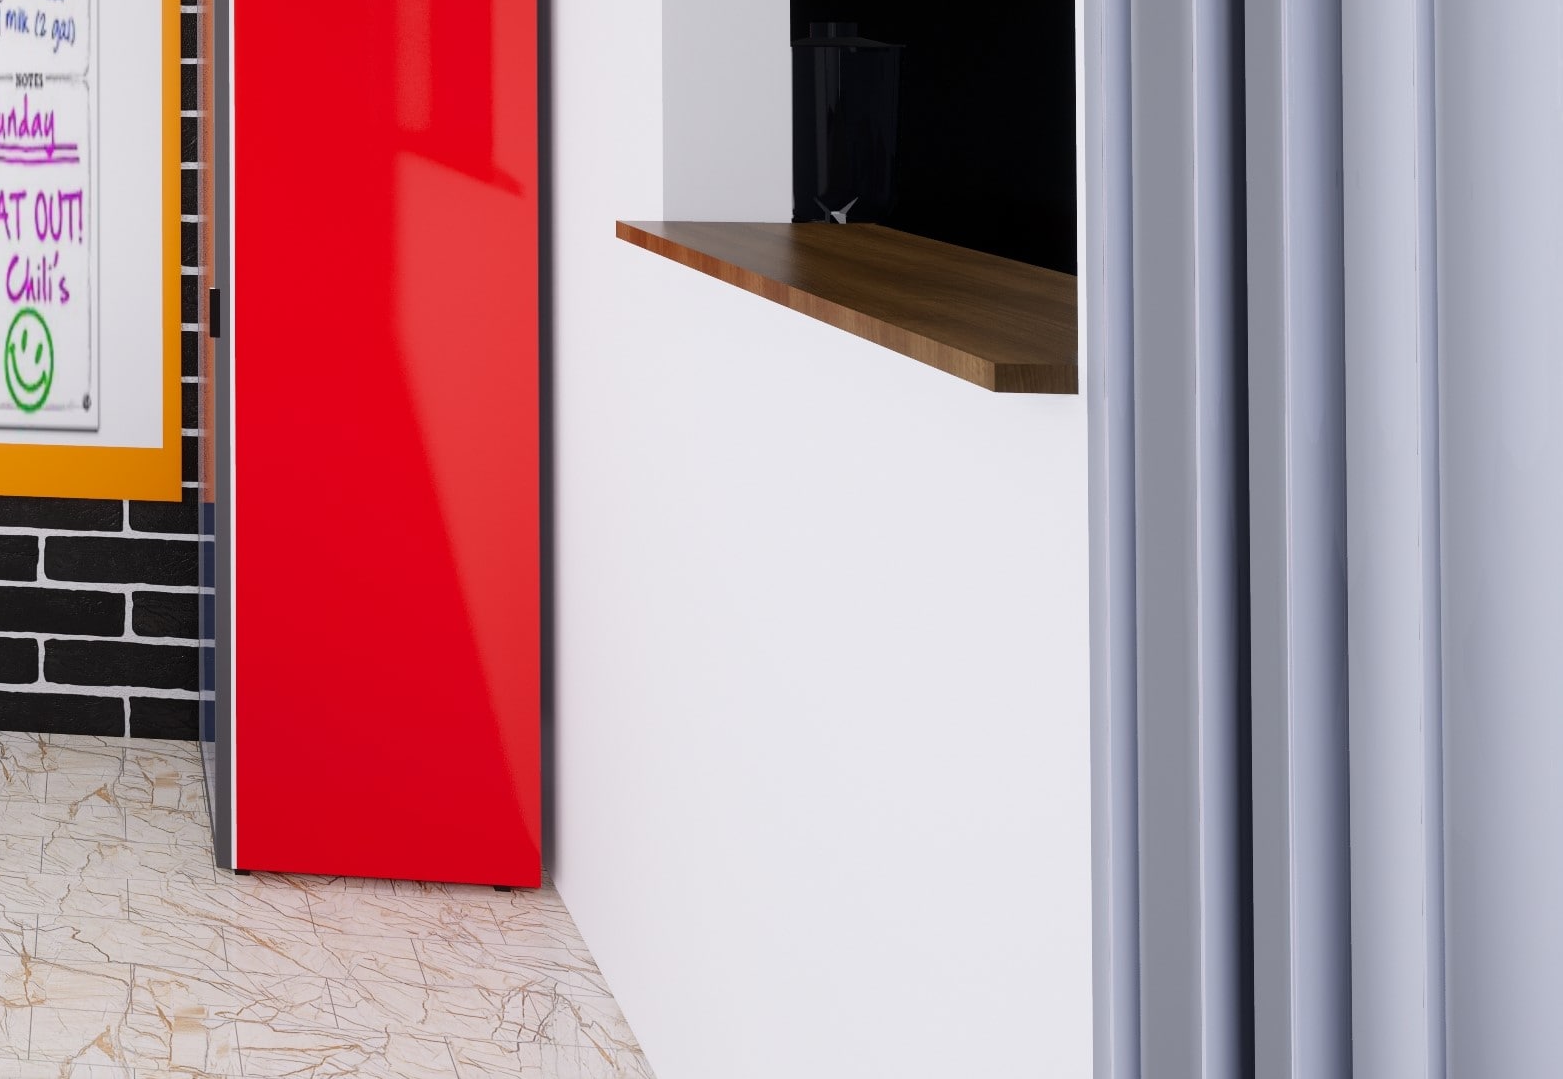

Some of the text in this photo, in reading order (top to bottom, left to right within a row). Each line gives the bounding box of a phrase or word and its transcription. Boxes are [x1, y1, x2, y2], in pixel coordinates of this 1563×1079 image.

[15, 73, 43, 88] NOTES
[34, 189, 83, 244] OUT!
[6, 250, 70, 304] Chili's
